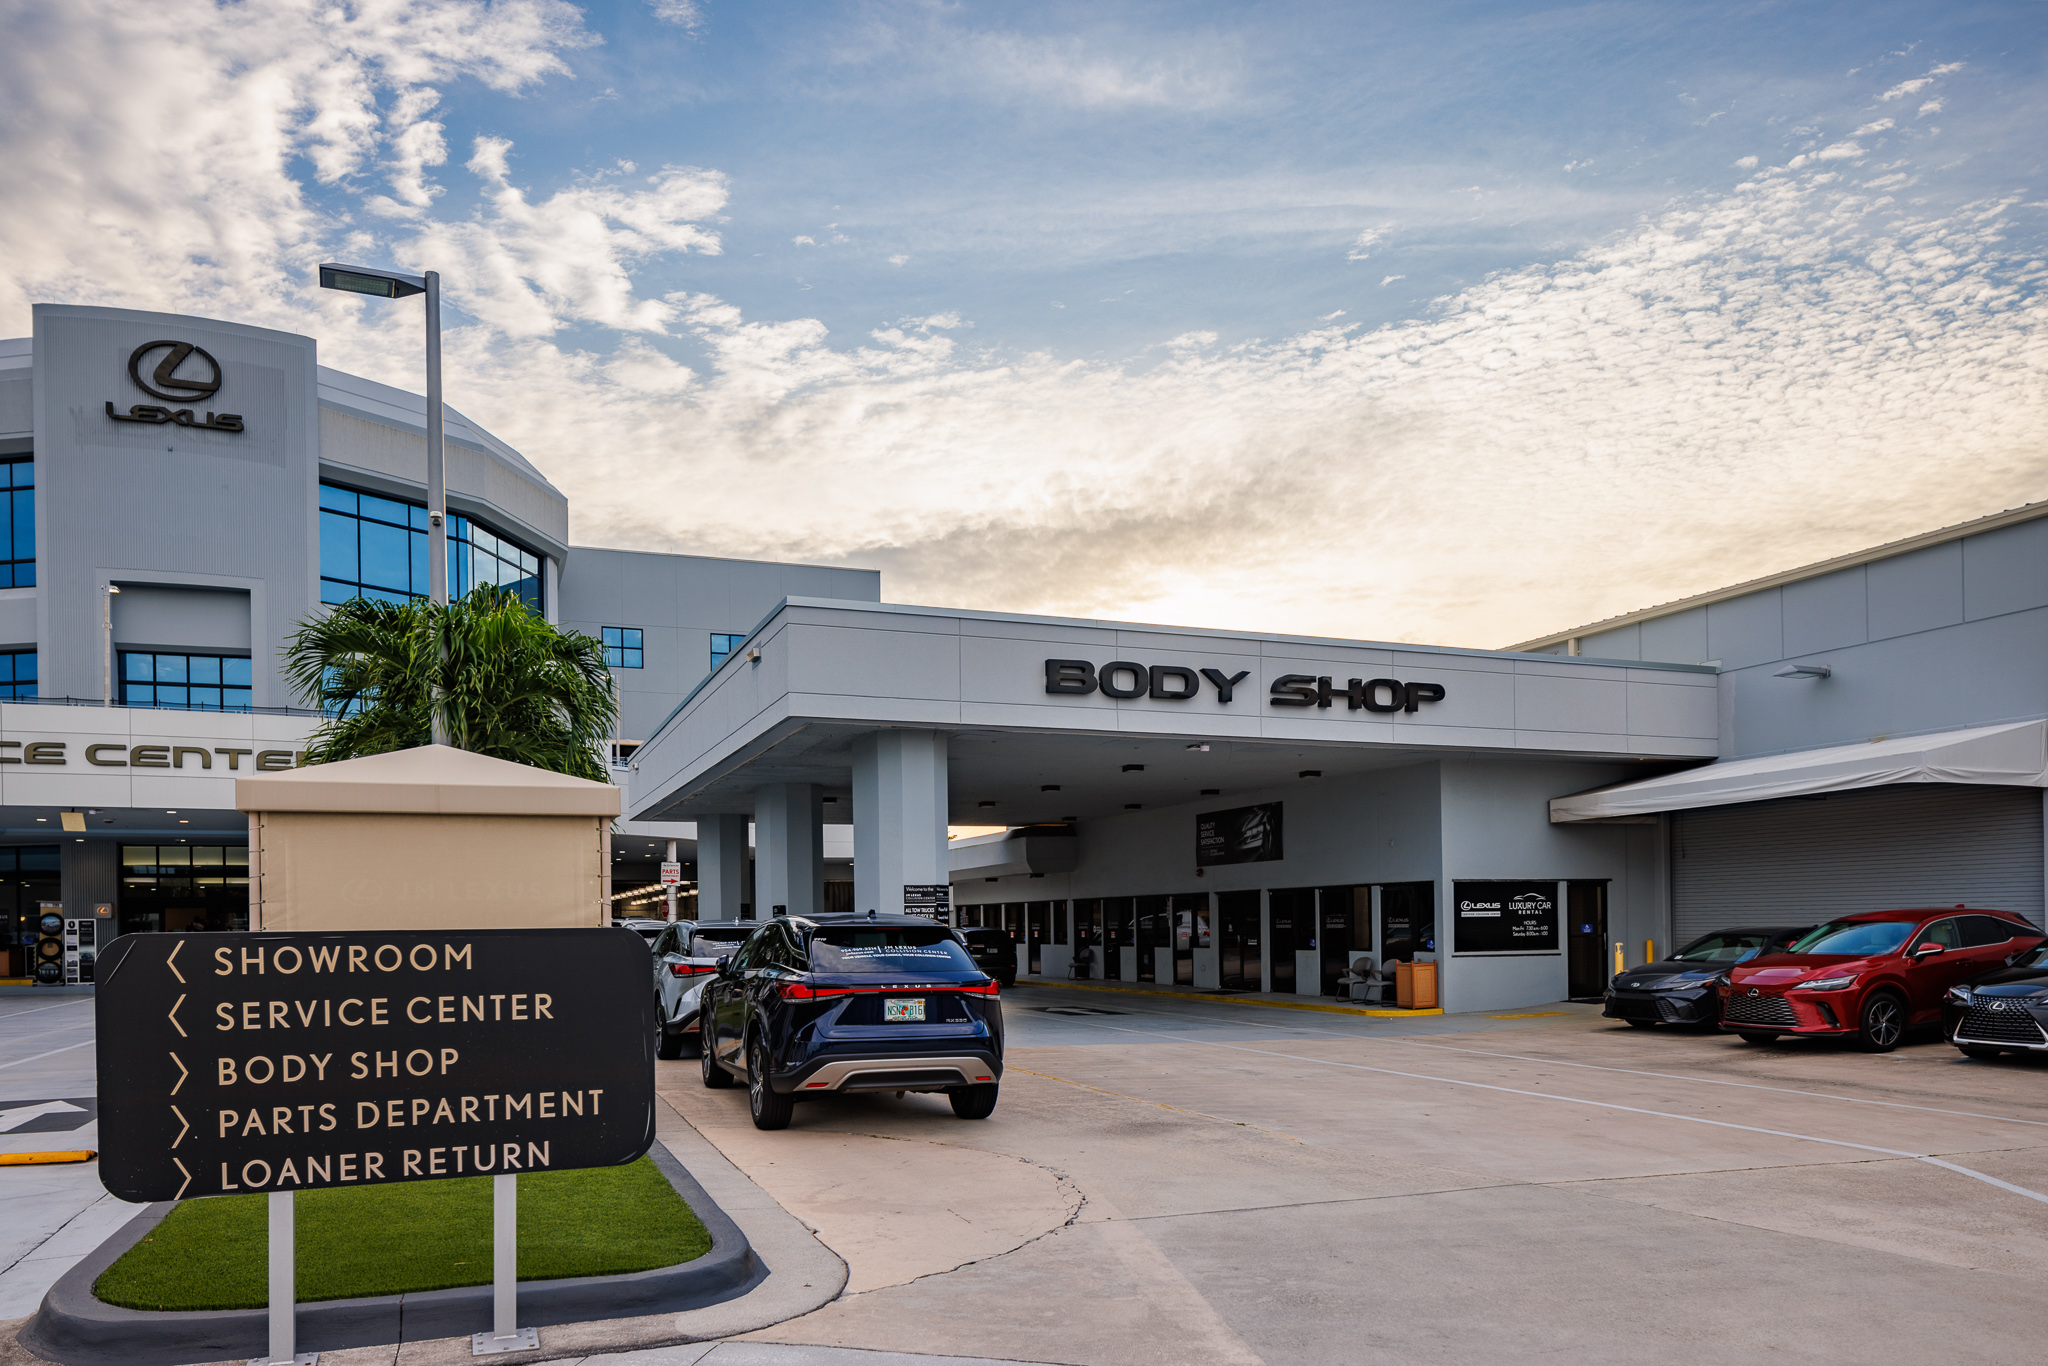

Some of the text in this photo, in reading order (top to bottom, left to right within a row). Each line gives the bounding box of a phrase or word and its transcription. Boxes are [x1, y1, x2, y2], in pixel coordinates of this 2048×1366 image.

[105, 401, 244, 431] LEXUS
[1044, 659, 1446, 713] BODY SHOP
[1200, 822, 1215, 830] QUALITY
[1200, 830, 1215, 838] SERVICE
[1200, 836, 1225, 845] SATISFACTION
[1508, 901, 1552, 910] LUXURY CAR
[215, 944, 472, 976] SHOWROOM
[216, 993, 554, 1031] SERVICE CENTER
[909, 1004, 923, 1016] B16
[218, 1048, 459, 1086] BODY SHOP
[219, 1090, 604, 1138] PARTS DEPARTMENT
[222, 1141, 550, 1190] LOANER RETURN
